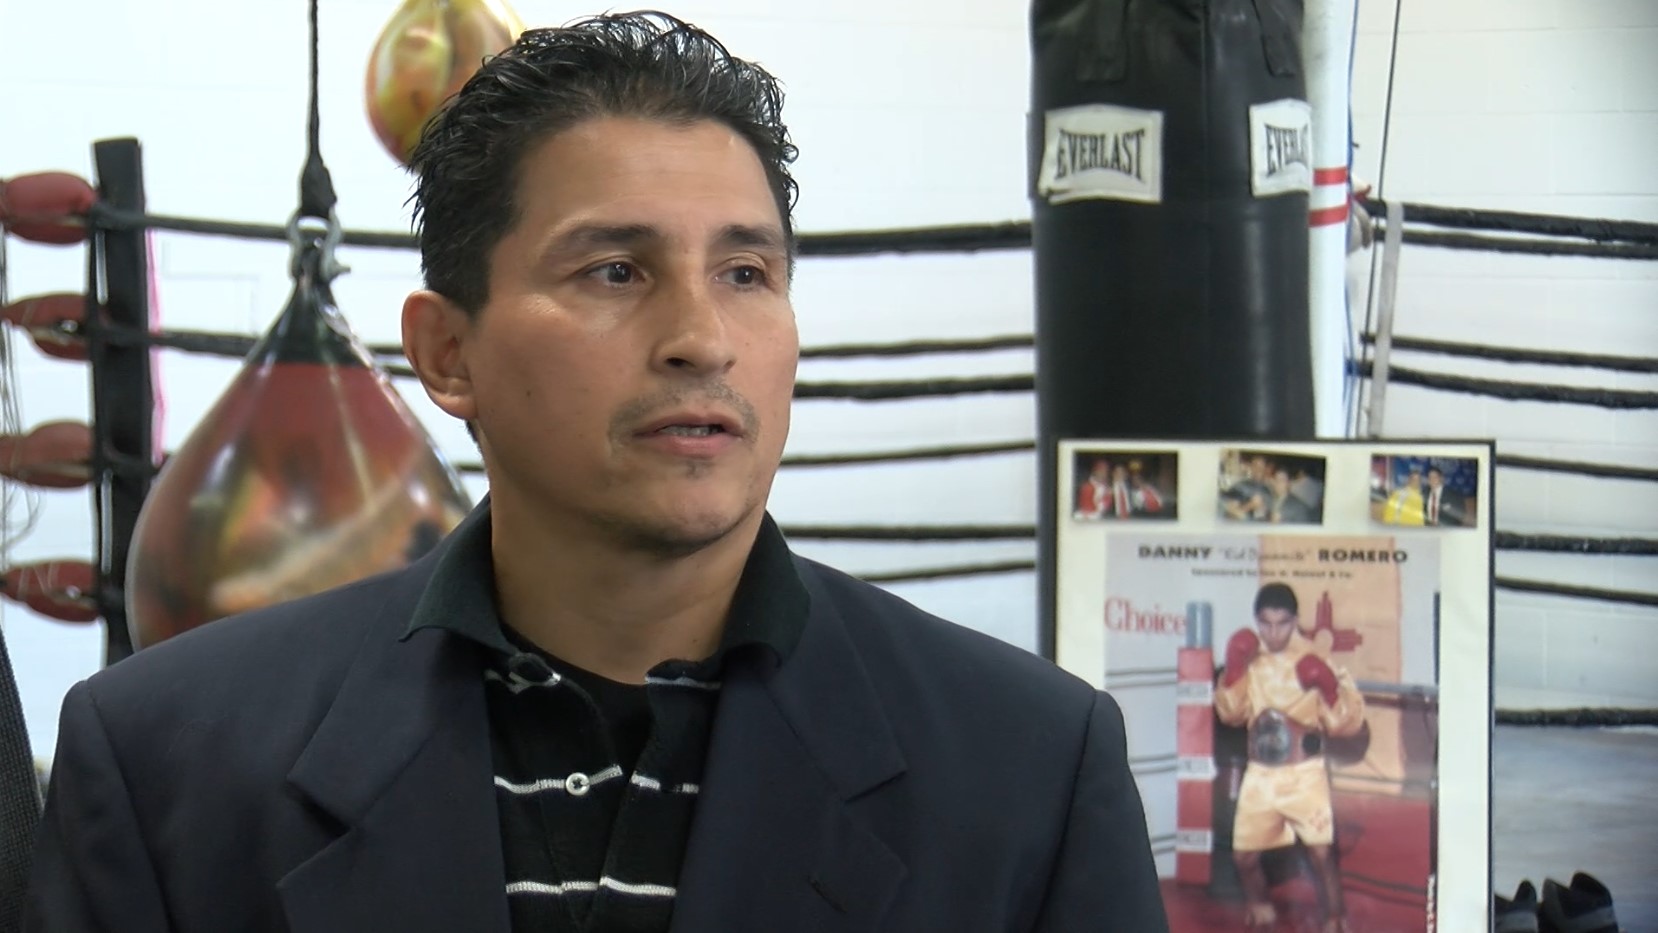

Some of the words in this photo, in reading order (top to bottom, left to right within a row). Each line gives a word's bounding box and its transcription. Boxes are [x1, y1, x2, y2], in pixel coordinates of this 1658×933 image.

[1055, 128, 1146, 183] EVERLAST
[1138, 545, 1212, 559] DANNY
[1318, 547, 1408, 562] ROMERO
[1103, 598, 1186, 636] Choice
